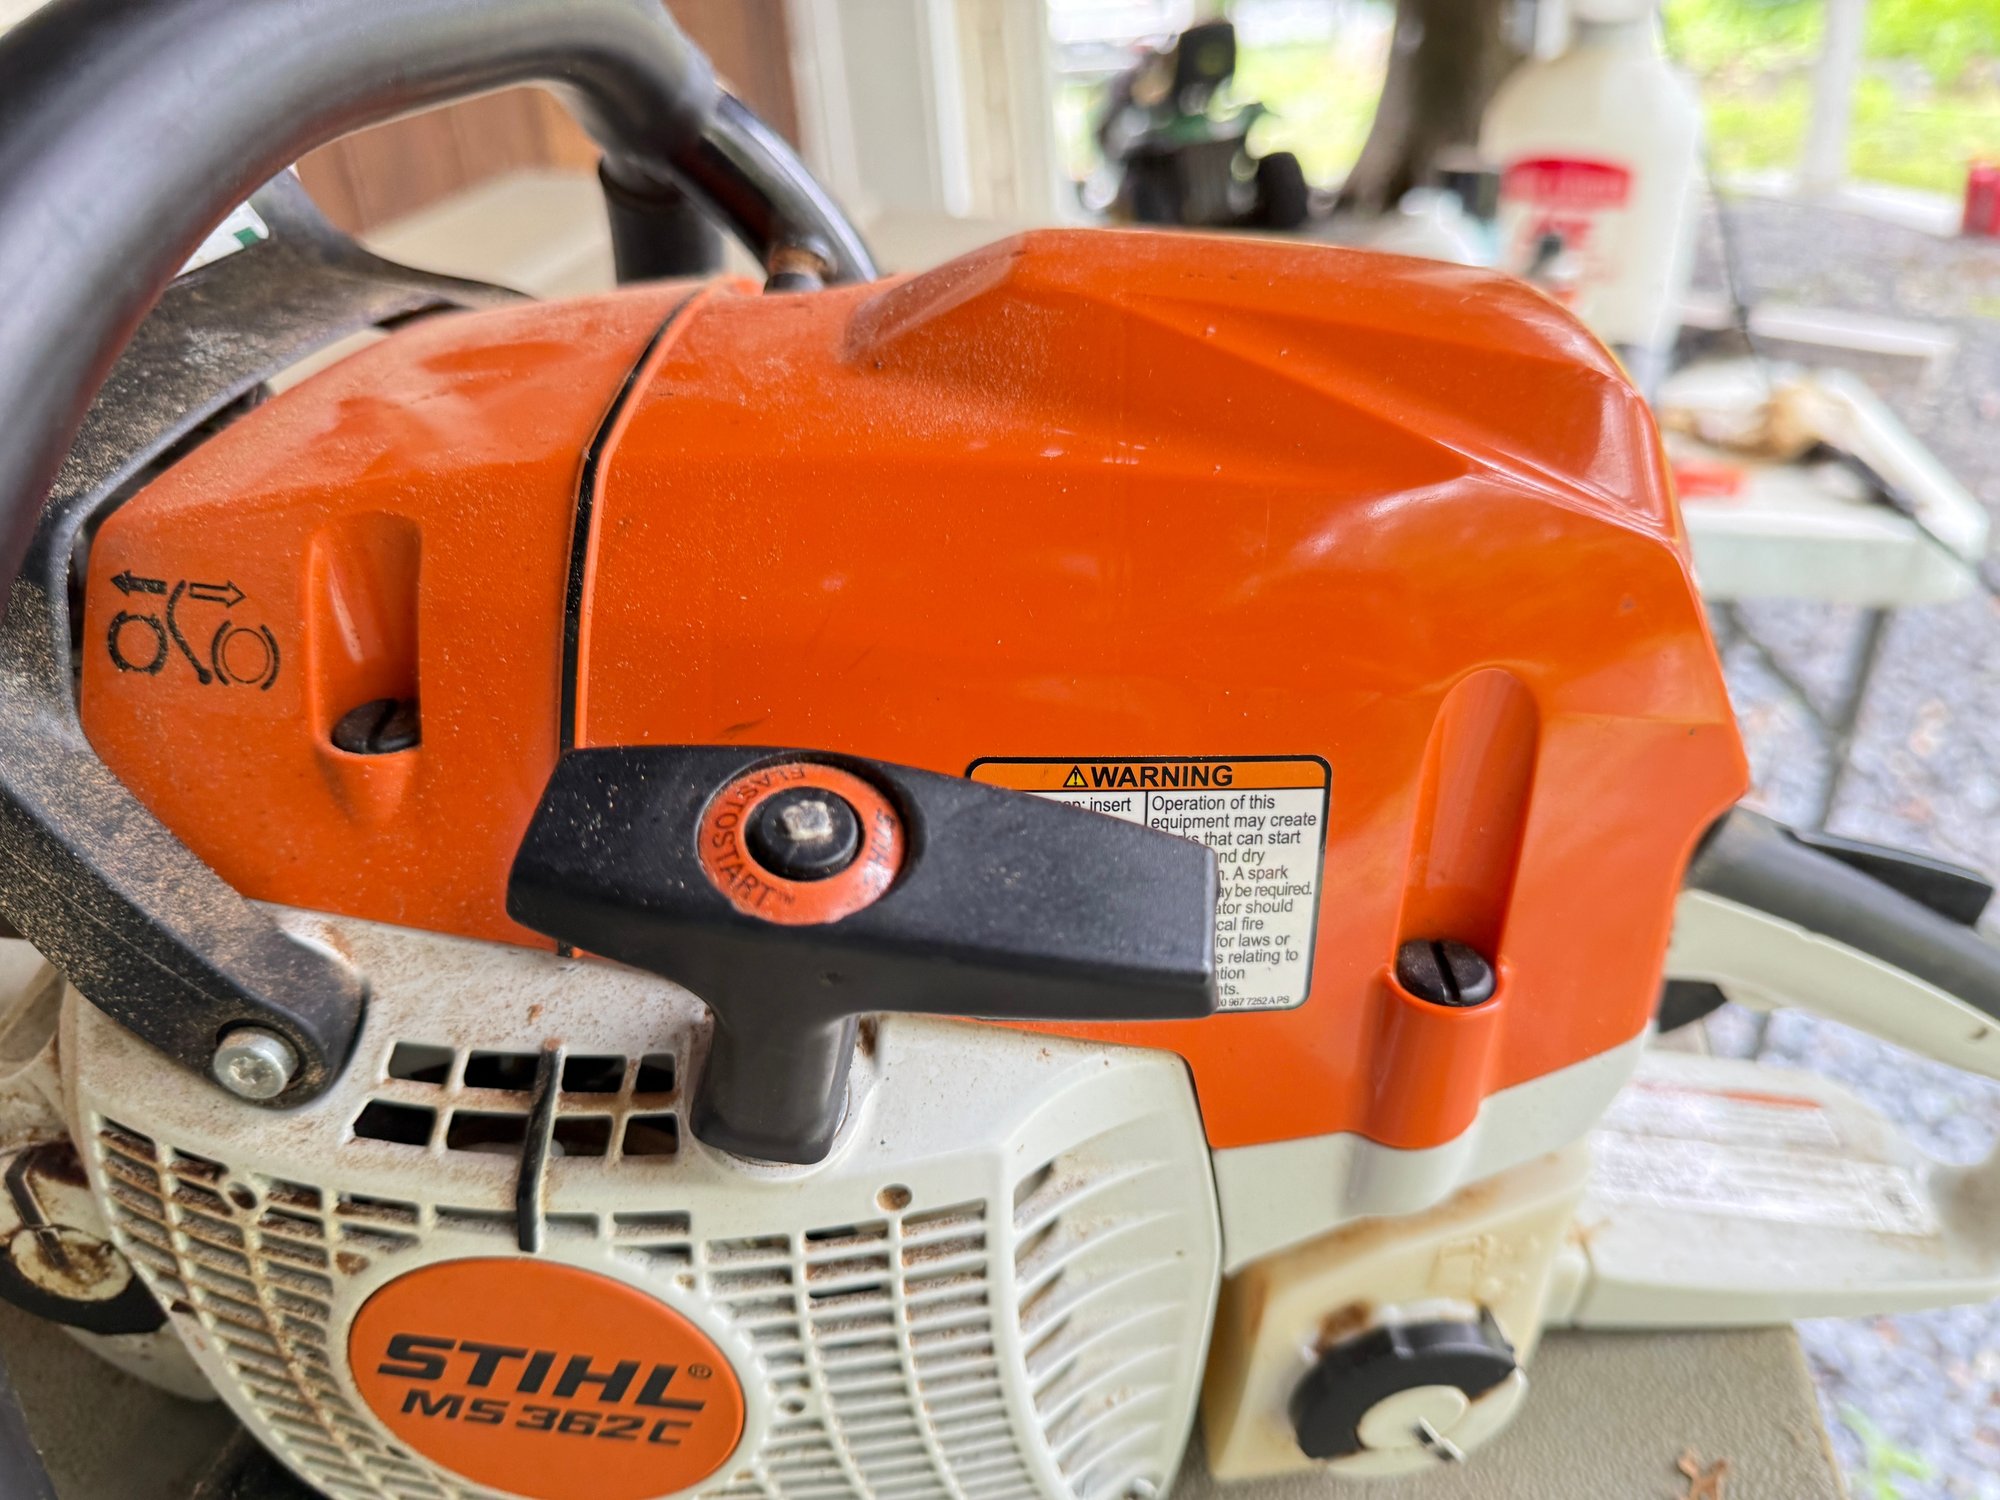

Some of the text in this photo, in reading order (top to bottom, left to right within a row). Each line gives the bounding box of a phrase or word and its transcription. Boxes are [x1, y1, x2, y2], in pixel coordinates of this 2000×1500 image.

[1091, 765, 1233, 788] WARNING
[1090, 796, 1131, 813] insert
[1152, 794, 1275, 814] Operation of this
[1151, 811, 1317, 835] equipment may create
[1204, 831, 1232, 846] that
[1236, 833, 1263, 845] can
[1268, 830, 1301, 844] start
[1217, 847, 1265, 865] nd dry
[1233, 865, 1244, 881] A
[1248, 865, 1288, 884] spark
[1235, 882, 1252, 898] be
[1255, 880, 1312, 901] required.
[1215, 898, 1294, 915] ator should
[1216, 916, 1264, 932] cal fire
[1216, 934, 1291, 948] for laws or
[1228, 948, 1281, 966] relating
[1285, 948, 1299, 961] to
[1228, 996, 1245, 1007] 967
[401, 1388, 511, 1426] MS
